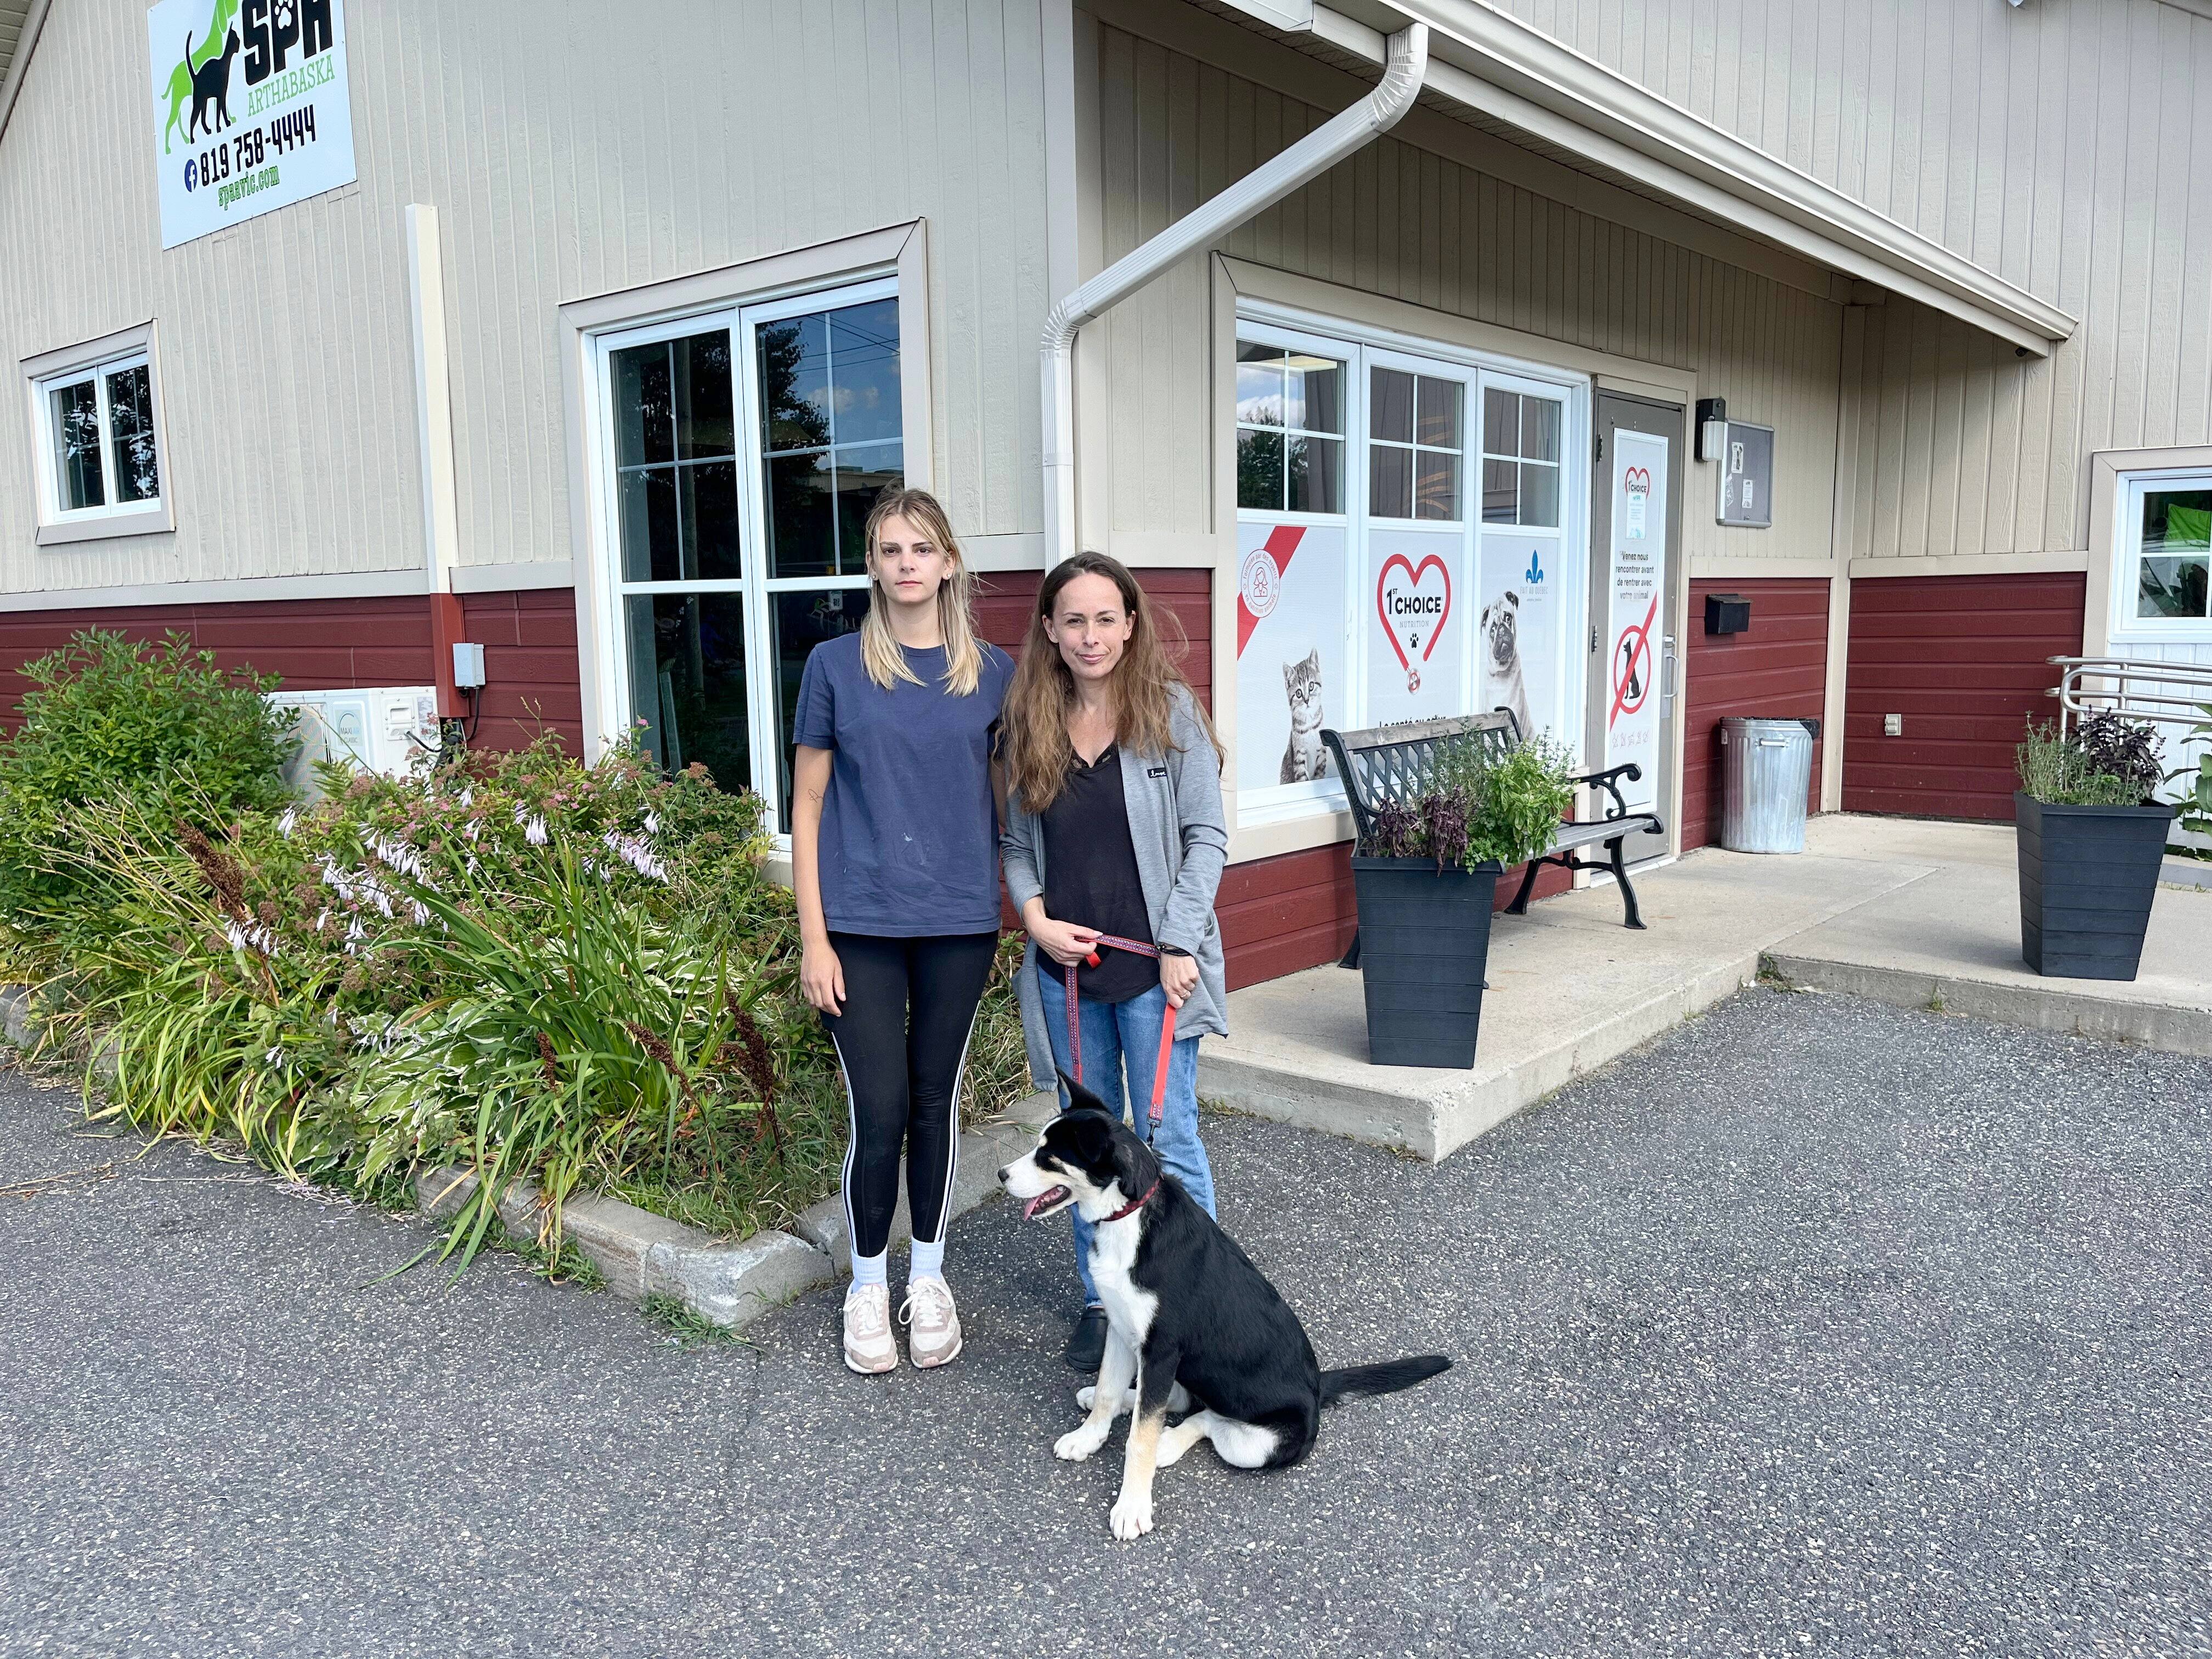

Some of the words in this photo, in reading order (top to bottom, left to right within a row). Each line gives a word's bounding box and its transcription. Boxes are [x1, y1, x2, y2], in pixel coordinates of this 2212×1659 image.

[242, 0, 333, 86] SPA
[248, 54, 335, 117] ARTHABASKA
[200, 143, 229, 187] 819
[234, 104, 316, 172] 758-4444
[218, 166, 280, 211] spaavic.com
[1630, 484, 1647, 493] CHOICE
[1621, 551, 1636, 560] Venez
[1641, 566, 1654, 574] avant
[1617, 577, 1623, 586] de
[1624, 578, 1640, 586] rentrer
[1386, 588, 1398, 614] 1ST
[1395, 596, 1441, 614] CHOICE
[1399, 620, 1429, 628] NUTRITION
